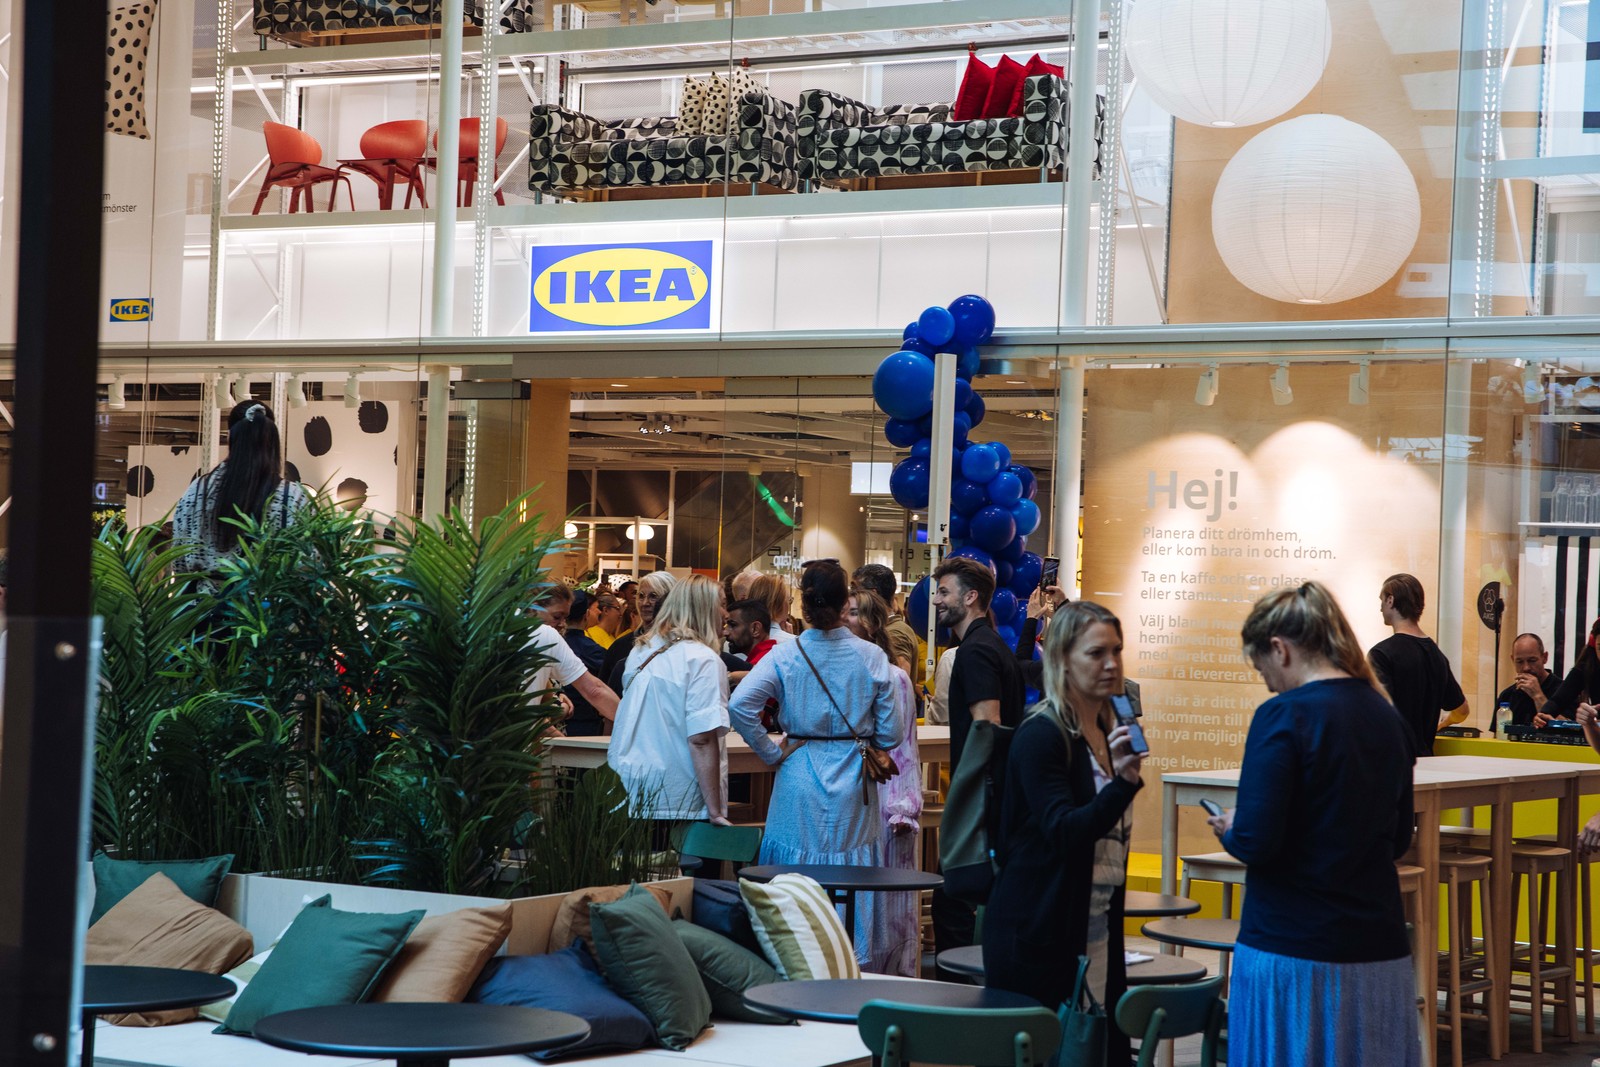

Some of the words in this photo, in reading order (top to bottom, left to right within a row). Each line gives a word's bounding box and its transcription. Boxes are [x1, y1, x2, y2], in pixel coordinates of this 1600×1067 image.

[549, 267, 696, 305] IKEA
[115, 305, 150, 315] IKEA
[1147, 468, 1239, 522] Hej!
[1142, 526, 1195, 540] Planera
[1199, 527, 1224, 540] ditt
[1227, 528, 1302, 543] drömhem,
[1142, 543, 1172, 556] eller
[1176, 543, 1207, 557] kom
[1211, 544, 1243, 558] bara
[1246, 545, 1260, 558] in
[1263, 545, 1289, 559] och
[1293, 546, 1337, 560] dröm.
[1141, 571, 1156, 583] Ta
[1160, 572, 1176, 584] en
[1181, 571, 1216, 585] kaffe
[1220, 573, 1245, 586] och
[1249, 575, 1267, 586] en
[1140, 587, 1171, 600] eller
[1174, 588, 1223, 602] stanna
[1139, 614, 1164, 631] Välj
[1138, 648, 1169, 661] med
[1218, 651, 1246, 665] und
[1189, 667, 1253, 682] levererat
[1165, 694, 1189, 707] här
[1192, 695, 1206, 708] är
[1210, 696, 1236, 709] ditt
[1240, 698, 1257, 711] IK
[1144, 708, 1220, 726] älkommen
[1224, 713, 1243, 727] till
[1145, 726, 1161, 740] ch
[1164, 729, 1190, 743] nya
[1193, 728, 1248, 747] möjligh
[1181, 755, 1210, 770] leve
